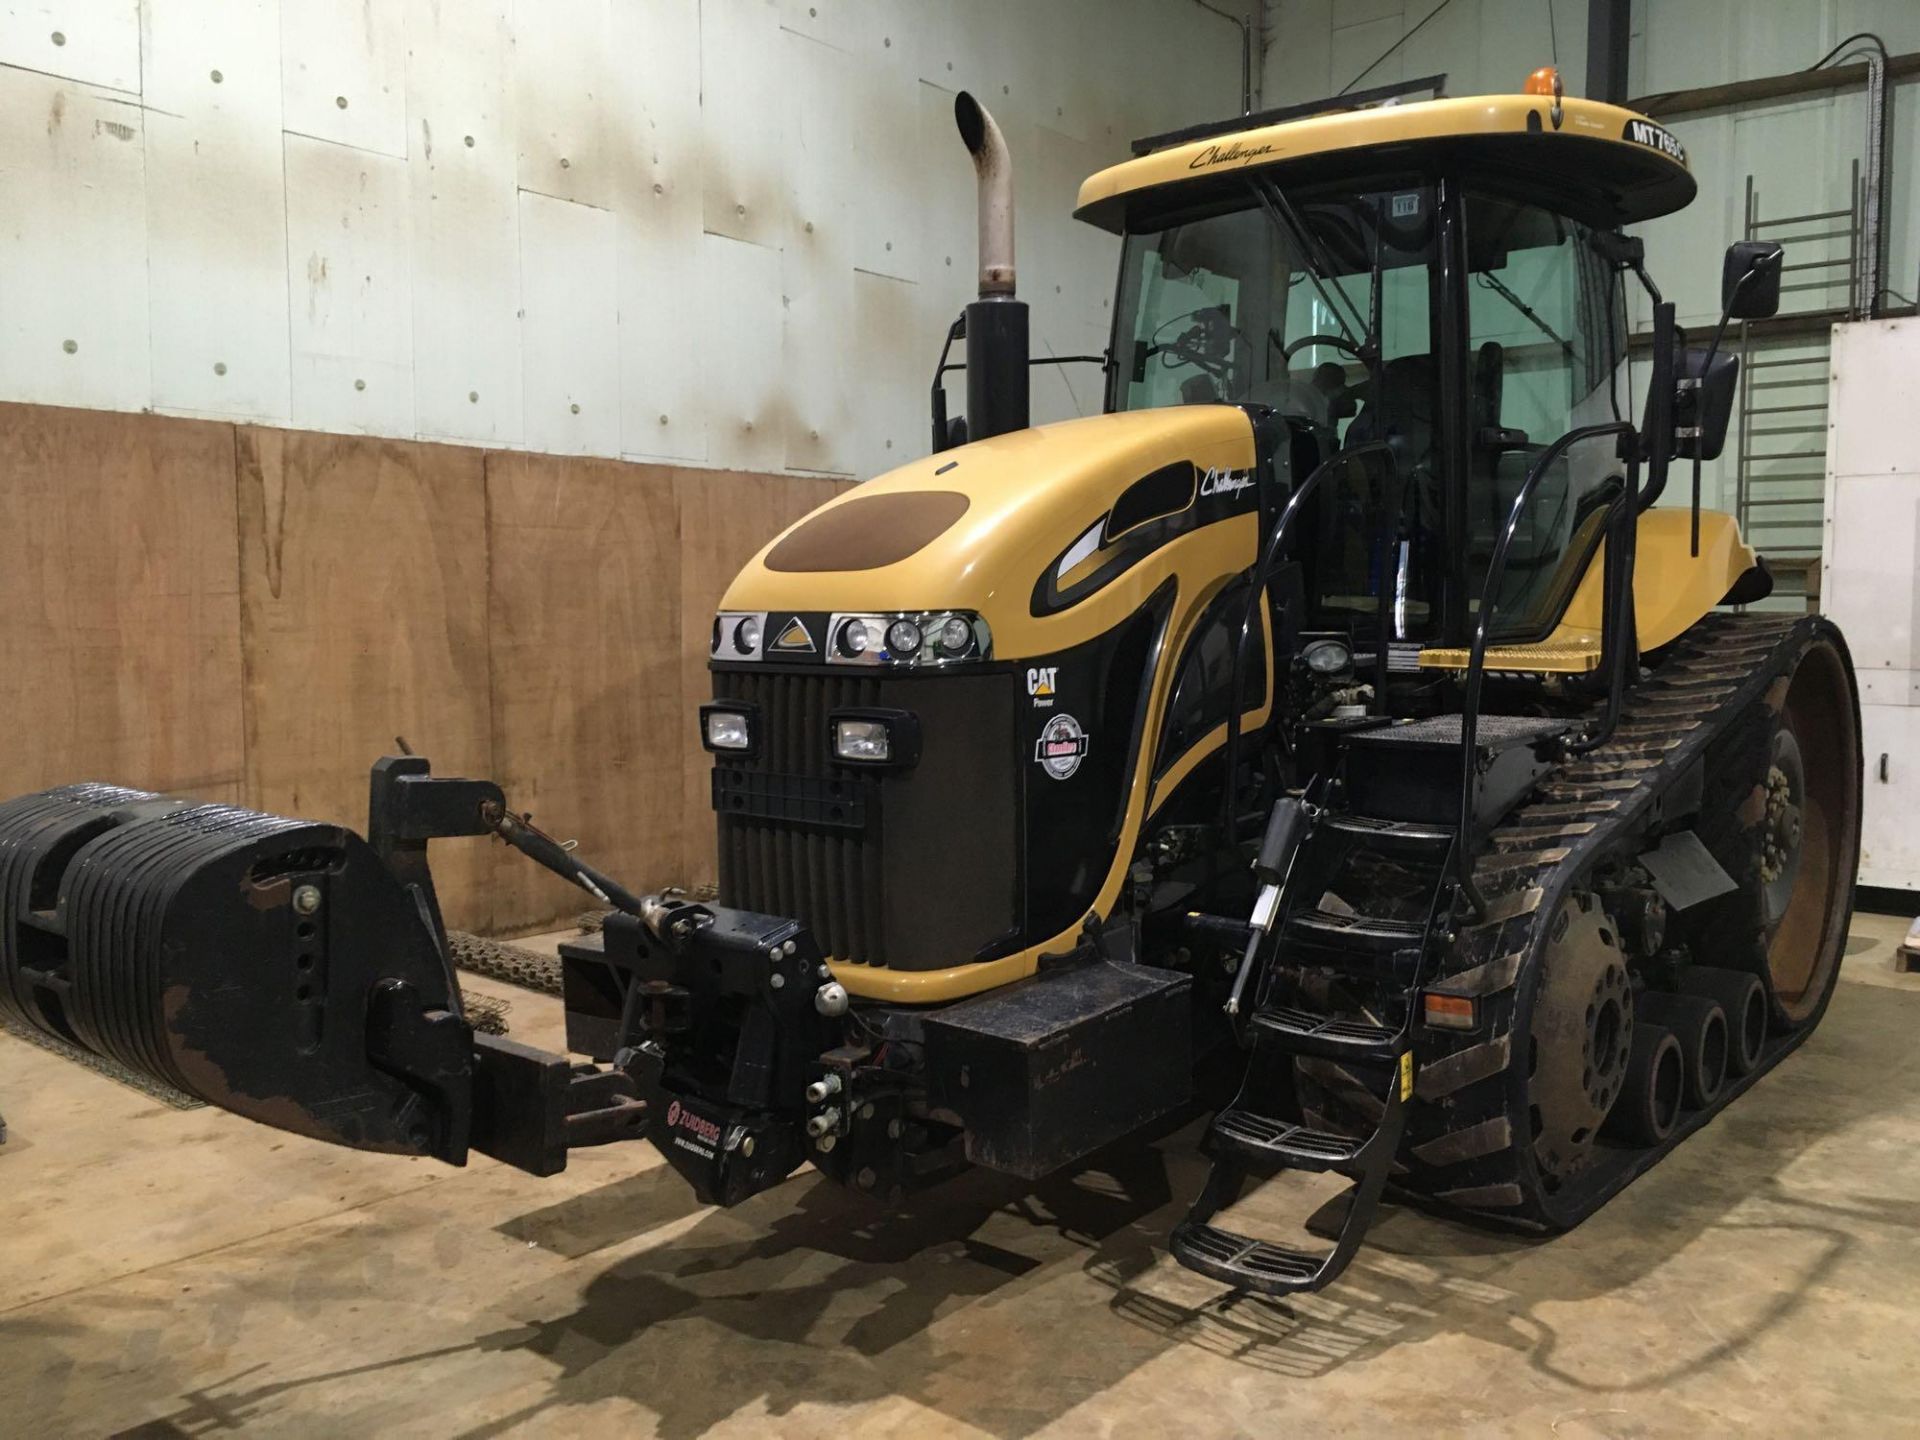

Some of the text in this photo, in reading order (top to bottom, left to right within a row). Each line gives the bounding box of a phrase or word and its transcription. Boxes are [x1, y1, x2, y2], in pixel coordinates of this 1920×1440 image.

[1189, 142, 1285, 169] Challenger
[1026, 667, 1056, 696] CAT
[680, 1108, 720, 1142] ZUIDBERG
